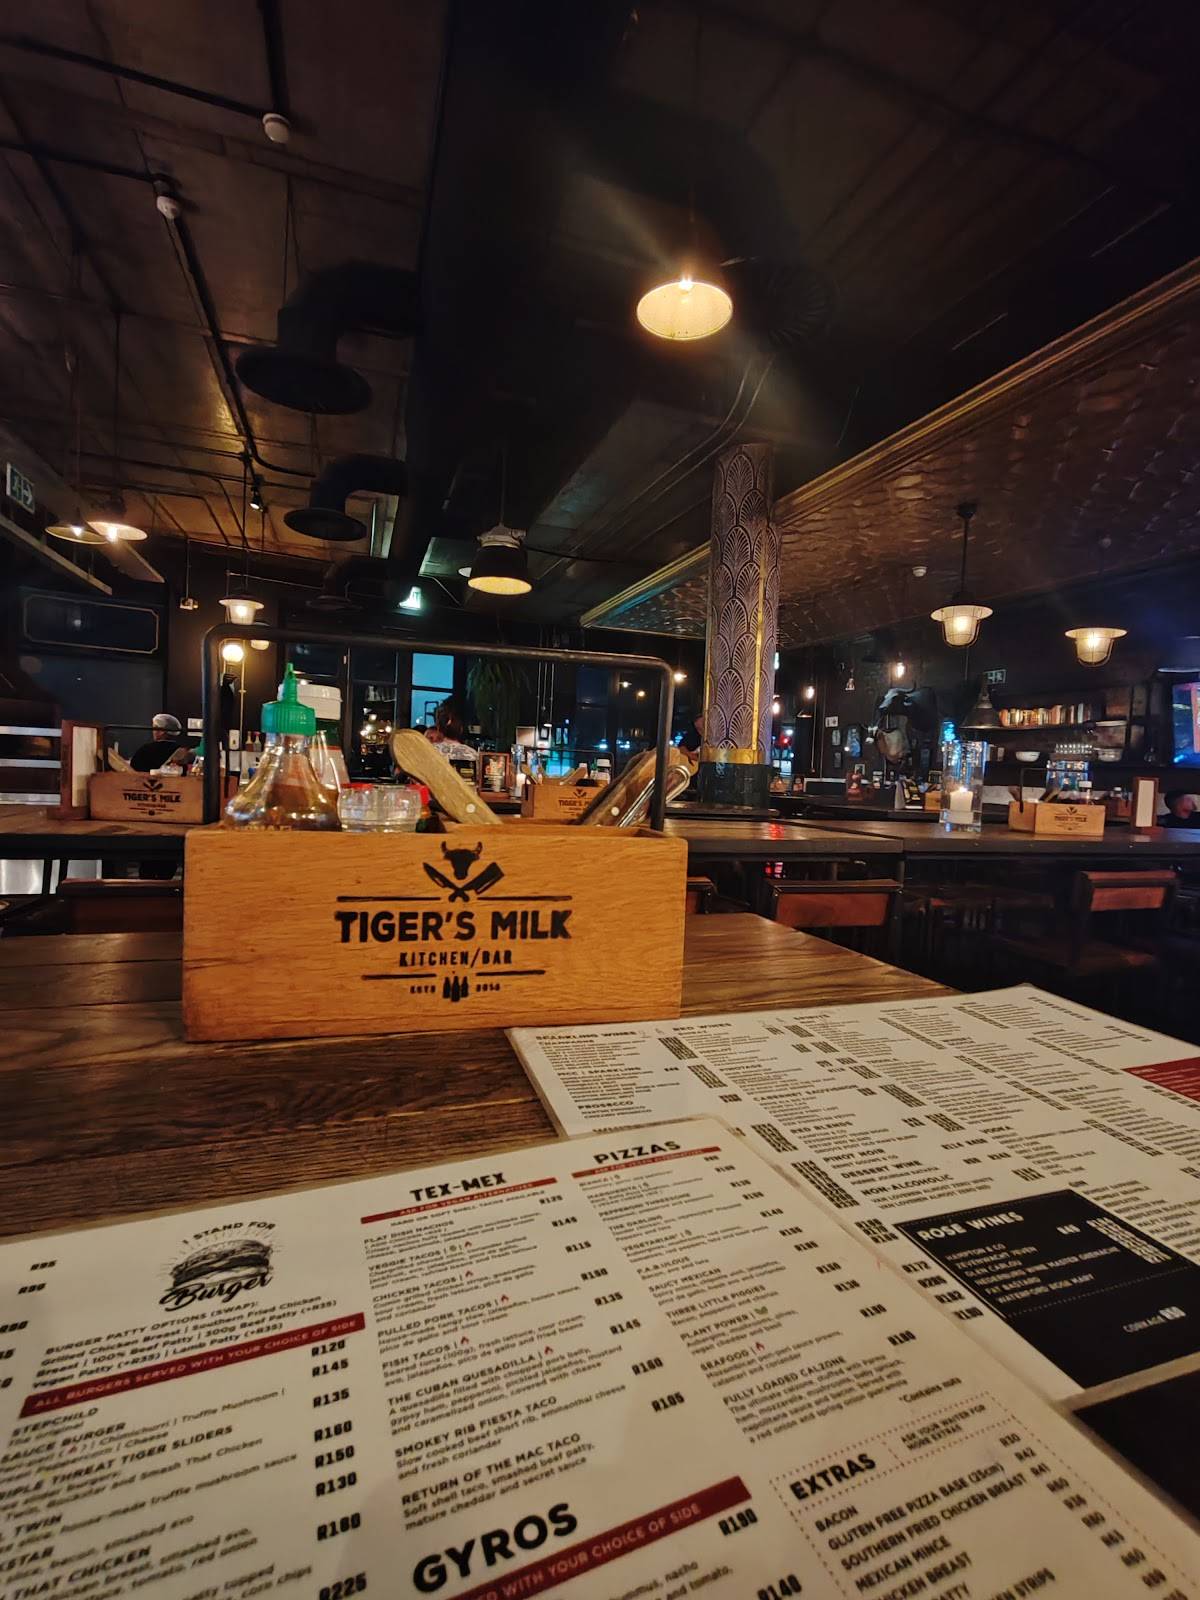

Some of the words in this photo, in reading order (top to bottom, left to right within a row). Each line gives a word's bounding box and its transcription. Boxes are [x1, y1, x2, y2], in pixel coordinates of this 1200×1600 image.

[335, 910, 476, 943] TIGER'S
[490, 909, 573, 940] MILK
[400, 947, 512, 968] KITCHEN/BAR
[577, 1100, 634, 1110] PROSECCO
[592, 1140, 682, 1165] PIZZAS
[822, 1152, 855, 1163] PINOT
[857, 1148, 885, 1157] NOIR
[840, 1165, 889, 1179] DESSERT
[892, 1160, 922, 1169] WINE
[409, 1172, 507, 1202] TEX-MEX
[861, 1175, 954, 1197] NON-ALCOHOLIC
[193, 1222, 244, 1241] STAND
[248, 1221, 276, 1231] FOR
[965, 1211, 1025, 1230] WINES
[368, 1258, 406, 1271] VEGGIE
[408, 1249, 441, 1261] TACOS
[565, 1240, 592, 1253] R115
[159, 1271, 273, 1312] Burger
[372, 1285, 420, 1302] CHICKEN
[423, 1276, 457, 1289] TACOS
[648, 1279, 678, 1292] SAUCY
[680, 1267, 721, 1283] MEXICAN
[594, 1291, 623, 1306] R135
[665, 1304, 697, 1318] THREE
[697, 1295, 730, 1309] LITTLE
[730, 1284, 766, 1299] PIGGIES
[40, 1350, 86, 1367] Grilled
[88, 1339, 139, 1355] Chicken
[142, 1328, 181, 1343] Breast
[191, 1314, 244, 1331] Southern
[247, 1305, 276, 1318] Fried
[278, 1295, 321, 1310] Chicken
[44, 1336, 102, 1355] BURGER
[105, 1326, 147, 1341] PATTY
[150, 1312, 207, 1331] OPTIONS
[377, 1320, 421, 1338] PULLED
[423, 1311, 454, 1325] PORK
[457, 1301, 492, 1315] TACOS
[609, 1318, 641, 1335] R145
[679, 1324, 712, 1341] PLANT
[713, 1313, 749, 1330] POWER
[35, 1362, 79, 1378] Breast
[129, 1342, 159, 1355] Beef
[161, 1335, 193, 1348] Patty
[239, 1316, 266, 1329] Beef
[268, 1310, 297, 1322] Patty
[78, 1364, 113, 1378] Patty
[172, 1341, 206, 1355] Lamb
[209, 1334, 240, 1346] Patty
[311, 1339, 345, 1357] R120
[381, 1356, 409, 1370] FISH
[412, 1344, 451, 1360] TACOS
[34, 1396, 60, 1408] ALL
[66, 1378, 130, 1399] BURGERS
[135, 1364, 186, 1382] SERVED
[190, 1354, 224, 1368] WITH
[227, 1345, 261, 1358] YOUR
[263, 1332, 308, 1349] CHOICE
[311, 1327, 328, 1337] OF
[330, 1320, 356, 1332] SIDE
[311, 1358, 349, 1377] R145
[700, 1349, 749, 1371] SEAFOOD
[387, 1392, 411, 1406] THE
[415, 1378, 459, 1397] CUBAN
[462, 1354, 535, 1382] QUESADILLA
[722, 1387, 754, 1406] FULLY
[756, 1372, 799, 1393] LOADED
[799, 1355, 846, 1377] CALZONE
[181, 1408, 218, 1422] Truffle
[221, 1391, 278, 1411] Mushroom
[312, 1388, 350, 1408] R135
[11, 1407, 98, 1438] STEPCHILD
[60, 1422, 125, 1447] BURGER
[394, 1432, 449, 1457] SMOKEY
[454, 1423, 476, 1438] RIB
[479, 1408, 522, 1429] FIESTA
[525, 1395, 557, 1413] TACO
[124, 1431, 169, 1448] Cheese
[52, 1459, 114, 1485] THREAT
[121, 1444, 167, 1464] TIGER
[171, 1425, 232, 1450] SLIDERS
[314, 1445, 355, 1468] R150
[401, 1477, 459, 1506] RETURN
[462, 1468, 481, 1482] OF
[485, 1457, 512, 1474] THE
[515, 1446, 544, 1464] MAC
[546, 1432, 581, 1452] TACO
[315, 1471, 357, 1497] R130
[403, 1502, 428, 1518] Soft
[431, 1491, 458, 1508] shell
[491, 1462, 538, 1486] smashed
[539, 1451, 563, 1467] beef
[789, 1453, 877, 1501] EXTRAS
[405, 1510, 447, 1531] mature
[450, 1491, 496, 1514] cheddar
[499, 1480, 520, 1495] and
[522, 1467, 555, 1486] secret
[557, 1456, 587, 1473] sauce
[15, 1514, 62, 1536] TWIN
[815, 1505, 859, 1533] BACON
[828, 1521, 876, 1551] GLUTEN
[875, 1506, 907, 1528] FREE
[905, 1491, 940, 1515] PIZZA
[938, 1477, 969, 1498] BASE
[840, 1529, 908, 1571] SOUTHERN
[905, 1515, 942, 1539] FRIED
[940, 1490, 989, 1521] CHICKEN
[986, 1473, 1028, 1499] BREAST
[412, 1502, 578, 1594] GYROS
[502, 1569, 545, 1599] WITH
[547, 1551, 590, 1584] YOUR
[591, 1526, 647, 1560] CHOICE
[647, 1518, 670, 1535] OF
[670, 1503, 703, 1525] SIDE
[8, 1575, 61, 1600] THAT
[67, 1546, 151, 1583] CHICKEN
[855, 1556, 913, 1593] MEXICAN
[911, 1535, 952, 1563] MINCE
[925, 1551, 973, 1585] BREAST
[318, 1571, 368, 1600] R225
